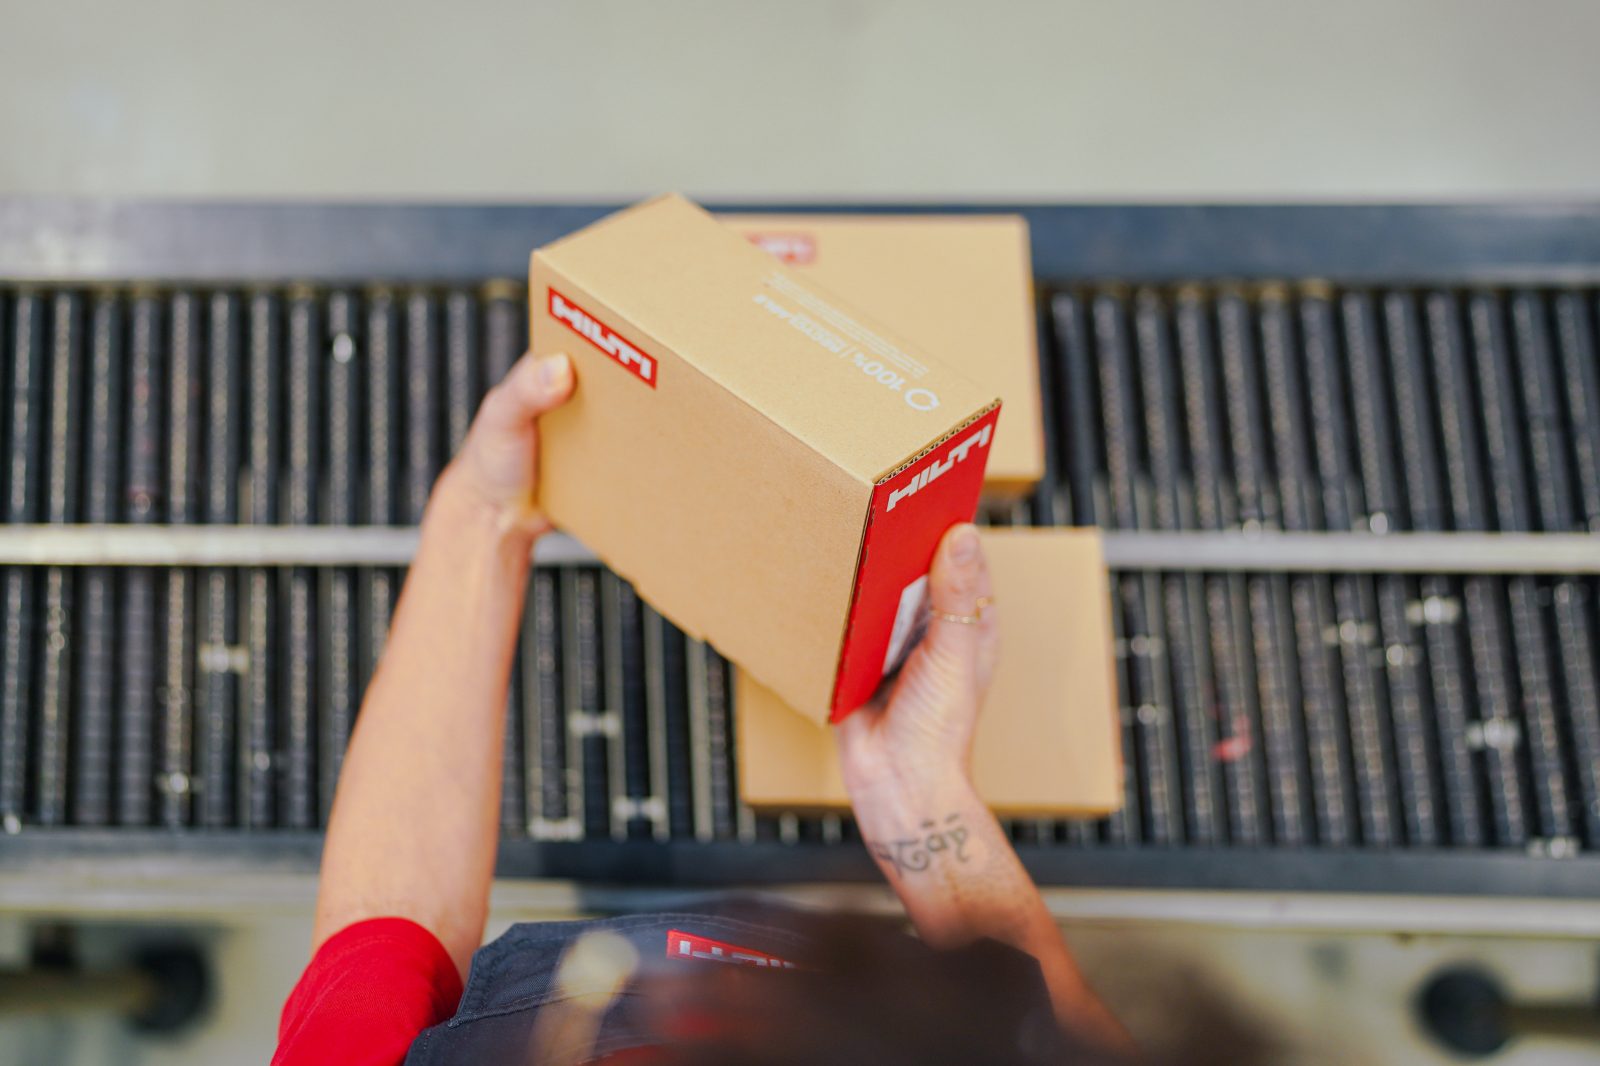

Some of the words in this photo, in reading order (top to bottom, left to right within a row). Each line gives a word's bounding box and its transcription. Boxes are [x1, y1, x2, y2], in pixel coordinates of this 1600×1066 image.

[551, 294, 652, 380] HILTI
[854, 352, 907, 392] 100%
[886, 423, 992, 512] HILTI
